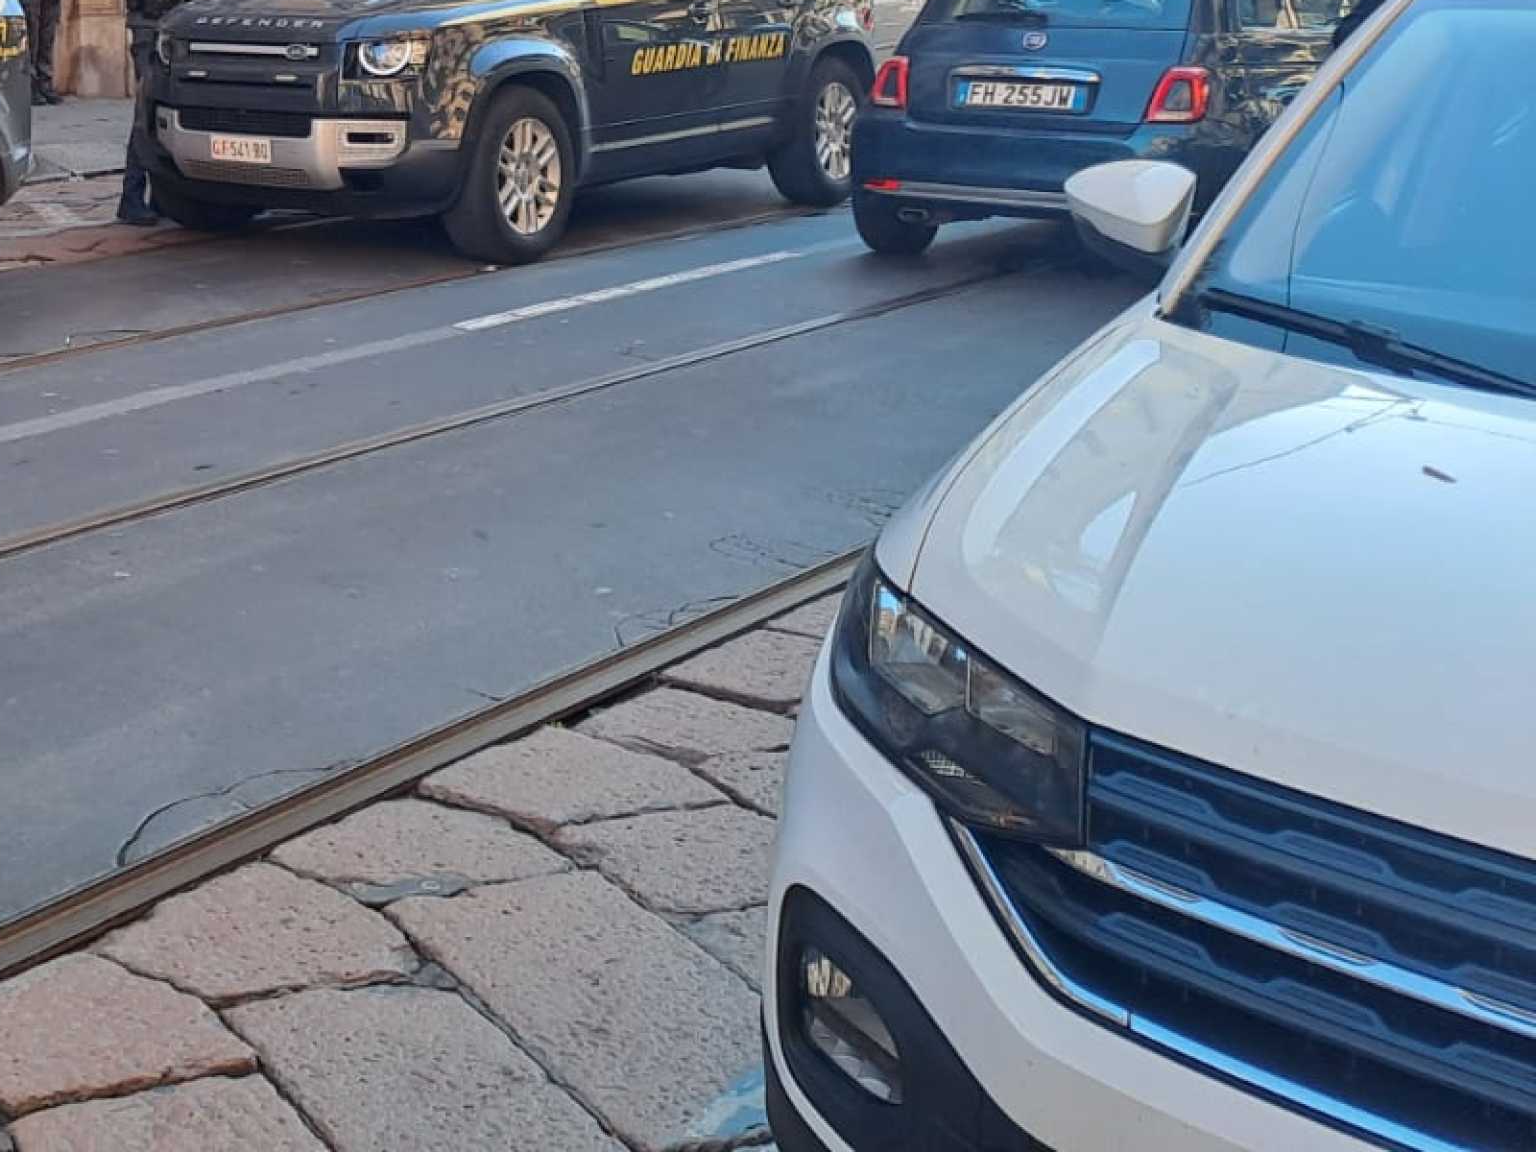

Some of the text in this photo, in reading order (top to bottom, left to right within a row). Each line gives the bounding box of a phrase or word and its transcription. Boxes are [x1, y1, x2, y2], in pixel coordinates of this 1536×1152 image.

[632, 32, 785, 76] GUARDIA di FINANZA
